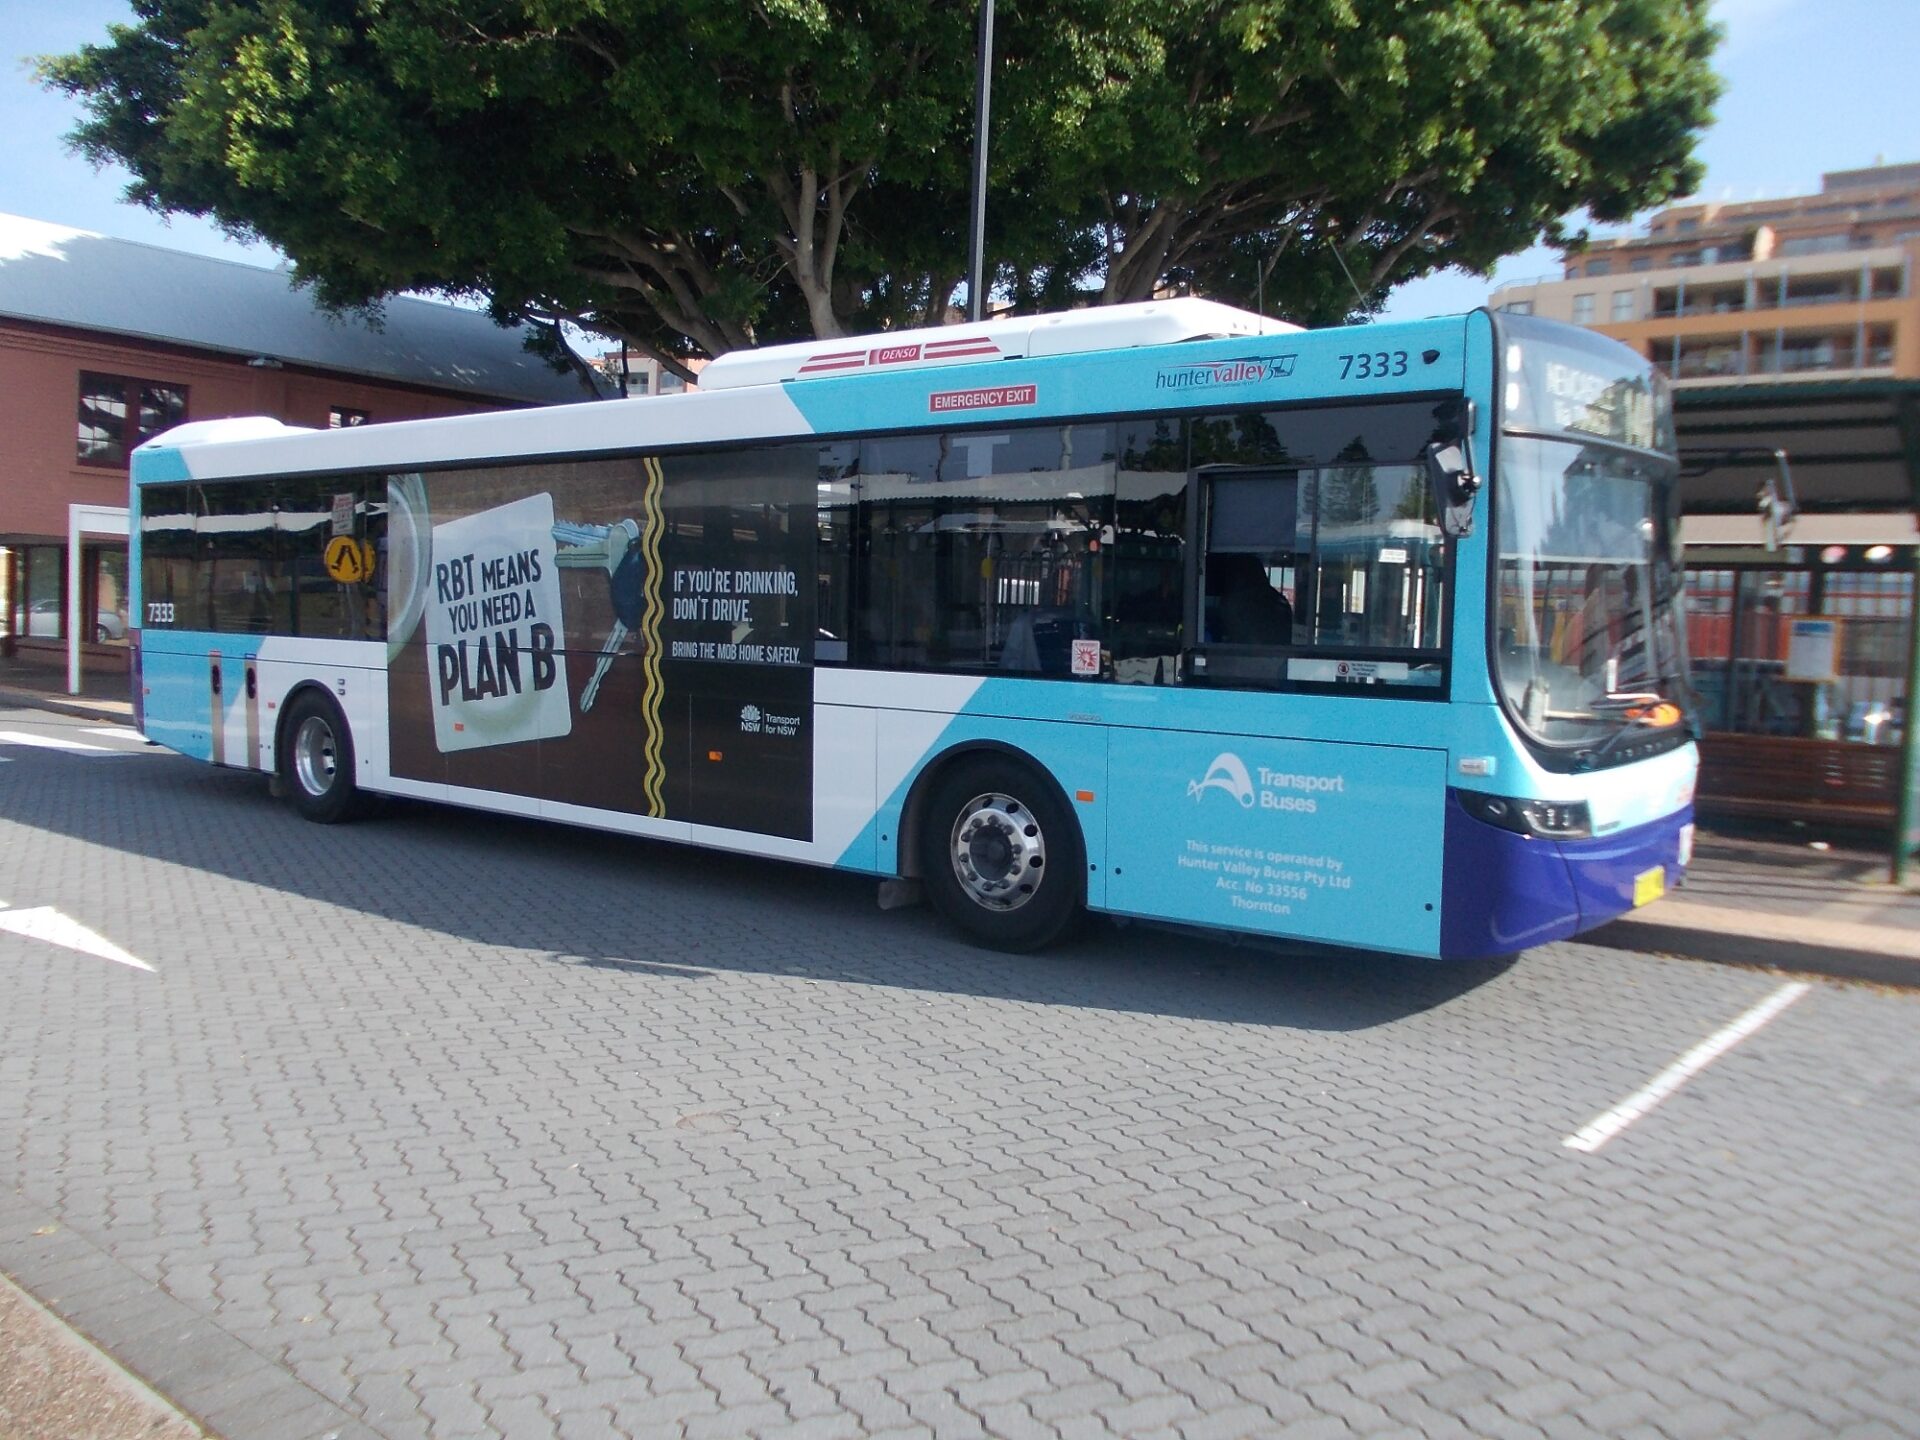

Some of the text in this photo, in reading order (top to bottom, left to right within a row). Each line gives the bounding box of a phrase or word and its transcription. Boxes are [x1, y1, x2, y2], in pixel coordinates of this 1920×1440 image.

[881, 347, 918, 361] DENSO
[1338, 351, 1408, 380] 7333
[1155, 363, 1268, 389] huntervalley
[935, 388, 1032, 409] EMERGENCY EXIT
[436, 549, 542, 604] RBT MEANS
[674, 567, 799, 597] IF YOU'RE DRINKING,
[148, 603, 175, 622] 7333
[448, 588, 537, 635] YOU NEED A
[673, 595, 753, 622] DON'T DRIVE.
[437, 622, 556, 707] PLAN B
[672, 641, 800, 664] BRING THE MOB HOME SAFELY.
[741, 721, 761, 732] NSW
[765, 713, 800, 726] Transport
[765, 724, 797, 736] for NSW
[1257, 767, 1344, 793] Transport
[1260, 790, 1317, 813] Buses
[1186, 839, 1343, 872] This service is operated by
[1178, 855, 1351, 889] Hunter Valley Buses Pty Ltd
[1245, 881, 1264, 894] No
[1266, 885, 1307, 900] 33556
[1231, 895, 1292, 915] Thornton
